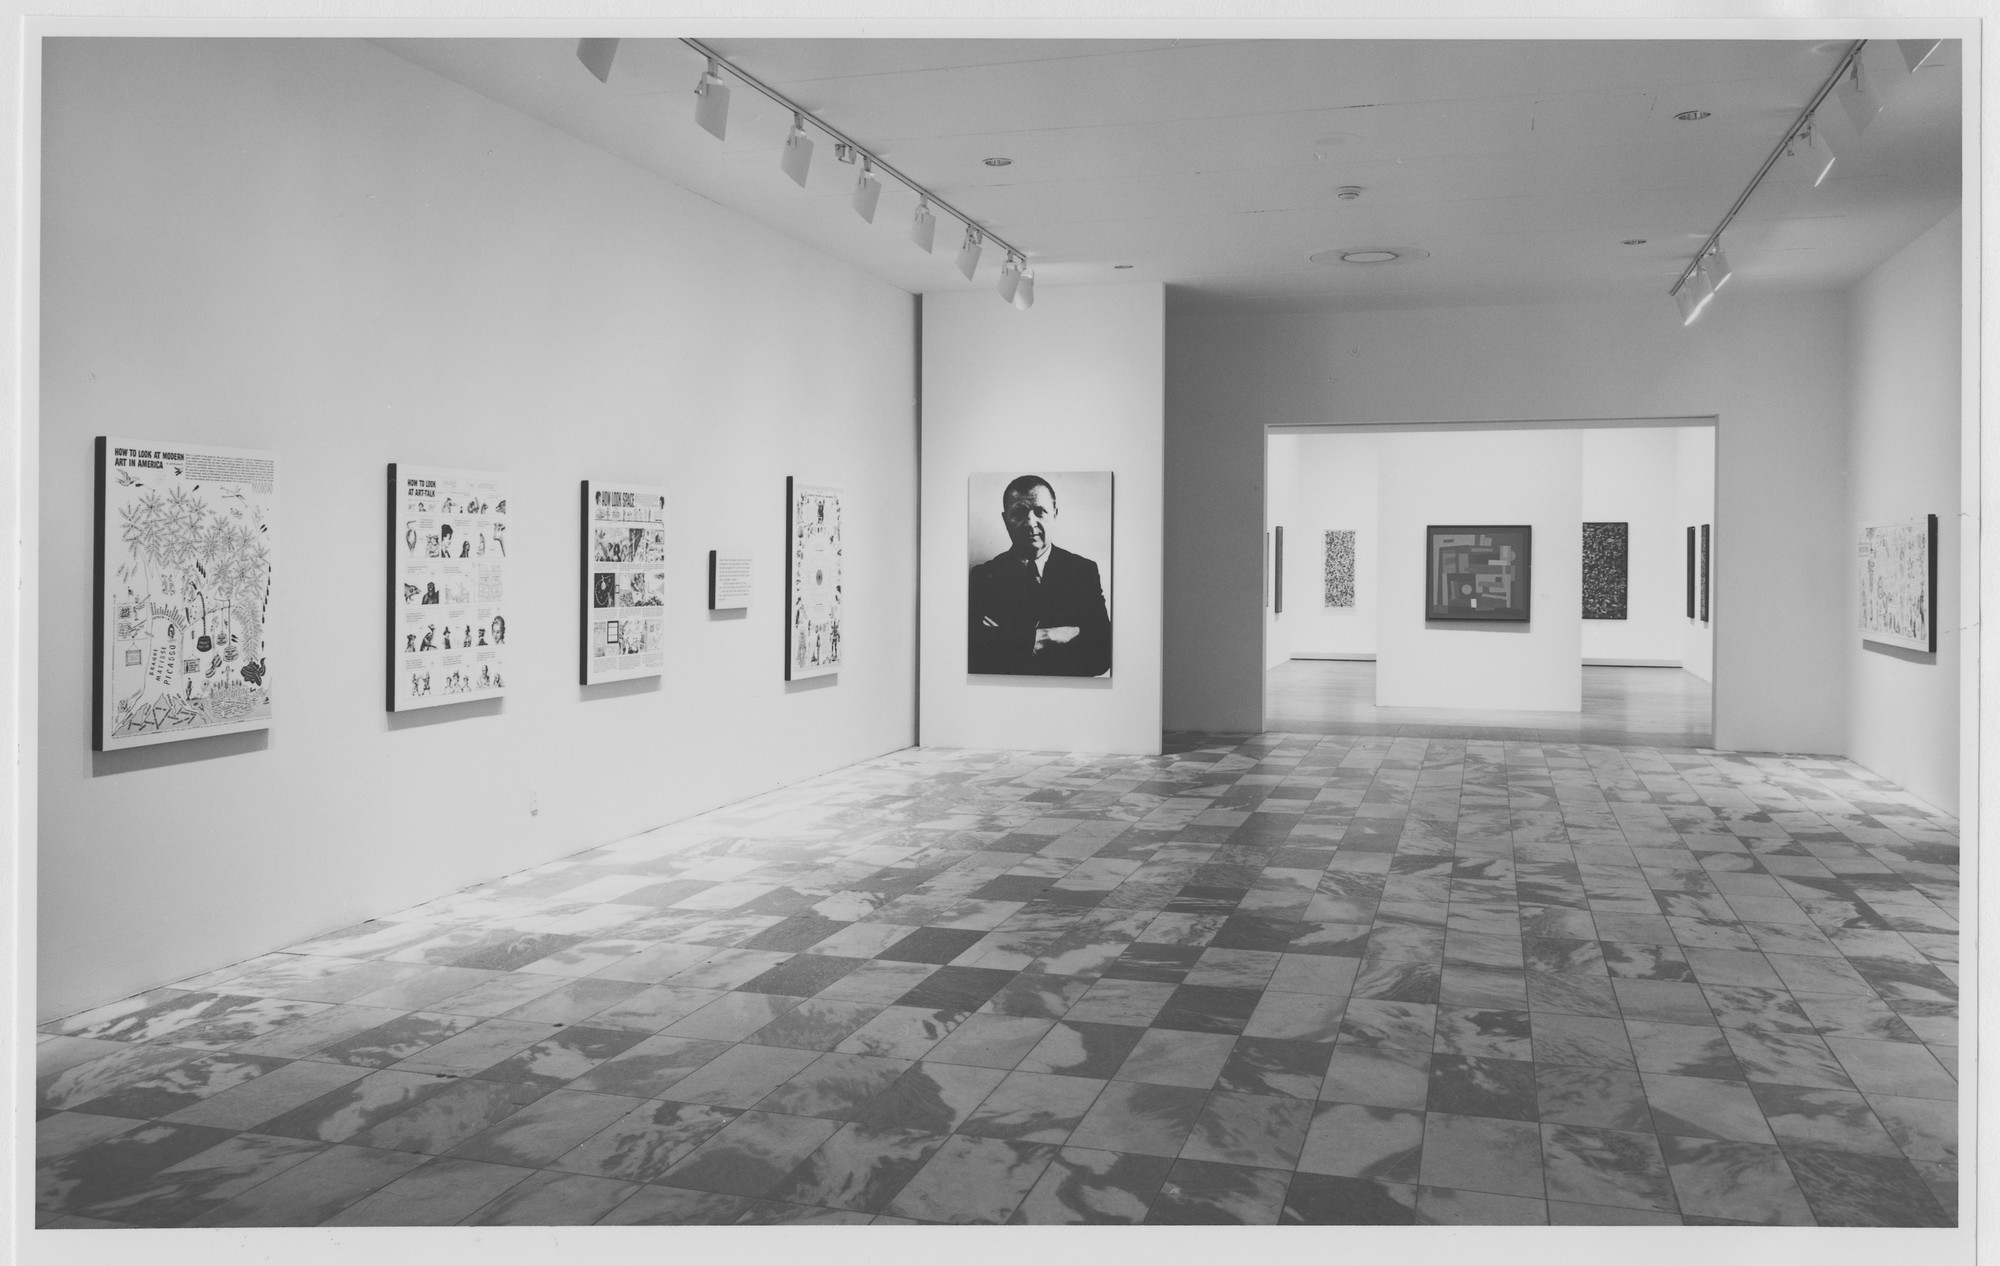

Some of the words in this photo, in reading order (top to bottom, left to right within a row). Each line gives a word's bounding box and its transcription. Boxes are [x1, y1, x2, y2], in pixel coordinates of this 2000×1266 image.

[114, 448, 128, 456] HOW
[129, 449, 137, 457] TO
[138, 450, 152, 459] LOOK
[153, 451, 161, 459] AT
[162, 452, 185, 461] MODERN
[114, 457, 127, 466] ART
[128, 459, 136, 467] IN
[137, 459, 164, 469] AMERICA
[407, 478, 418, 487] HOW
[419, 479, 425, 487] TO
[425, 480, 436, 488] LOOK
[408, 488, 414, 496] AT
[414, 488, 436, 498] ART-TALK
[148, 648, 158, 676] BRAQUE
[155, 646, 167, 682] MATISSE
[163, 645, 176, 686] PICASSO
